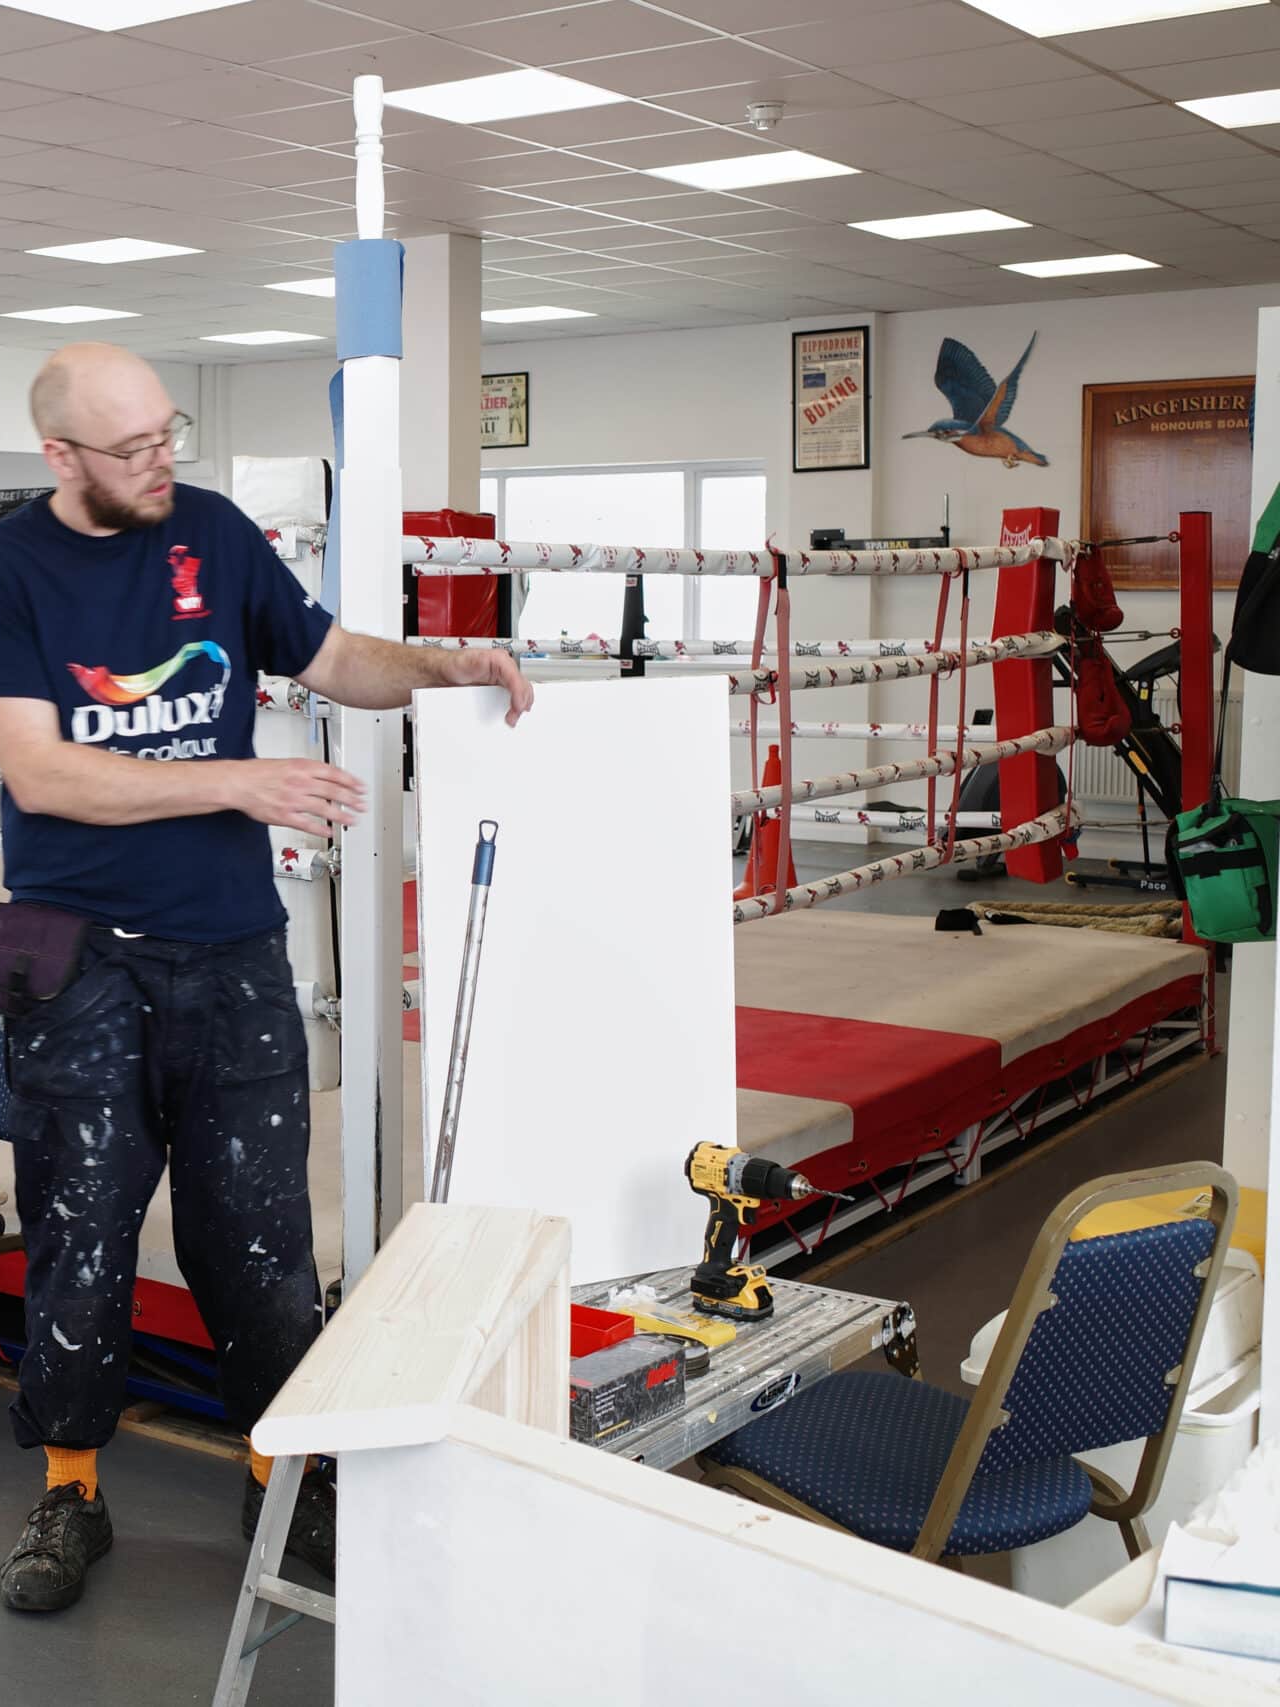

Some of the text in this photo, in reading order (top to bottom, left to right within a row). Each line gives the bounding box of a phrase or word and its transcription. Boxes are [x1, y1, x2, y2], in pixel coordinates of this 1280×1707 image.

[801, 336, 858, 353] HIPPODROME
[480, 397, 507, 410] ZIER
[803, 375, 858, 425] BOXING
[1114, 395, 1246, 425] KINGFISHER
[1151, 419, 1212, 432] HONOURS
[72, 692, 213, 743] Dulux
[1140, 880, 1167, 890] Pace
